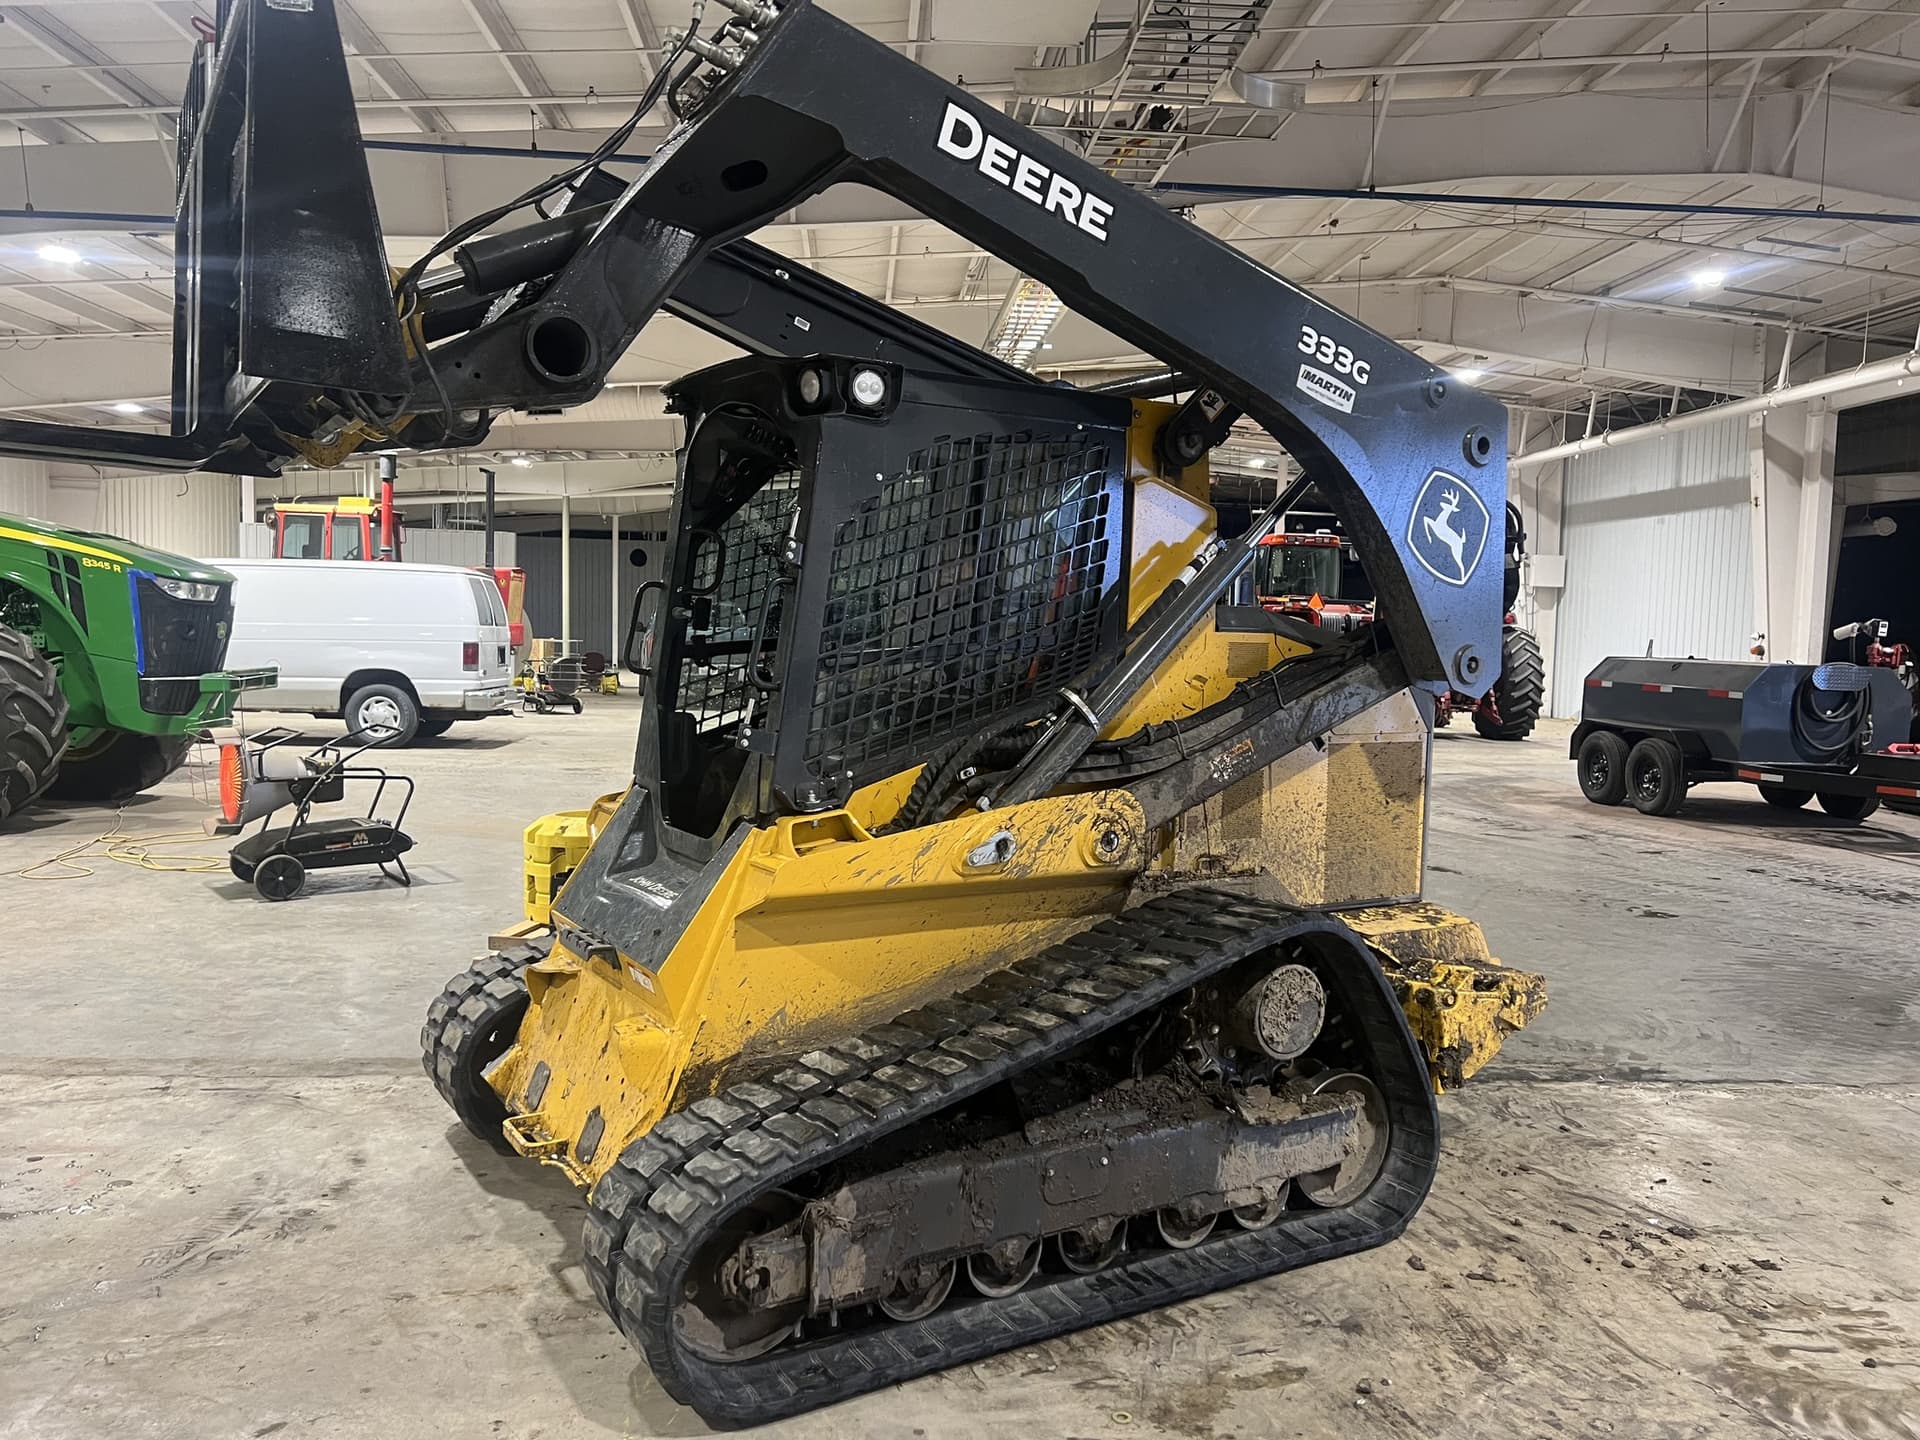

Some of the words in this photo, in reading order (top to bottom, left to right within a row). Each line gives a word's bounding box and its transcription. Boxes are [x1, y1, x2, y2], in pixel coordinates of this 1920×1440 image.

[937, 102, 1114, 241] DEERE
[1298, 325, 1371, 385] 333G
[1302, 369, 1353, 402] MARTIN
[82, 557, 111, 570] 8345
